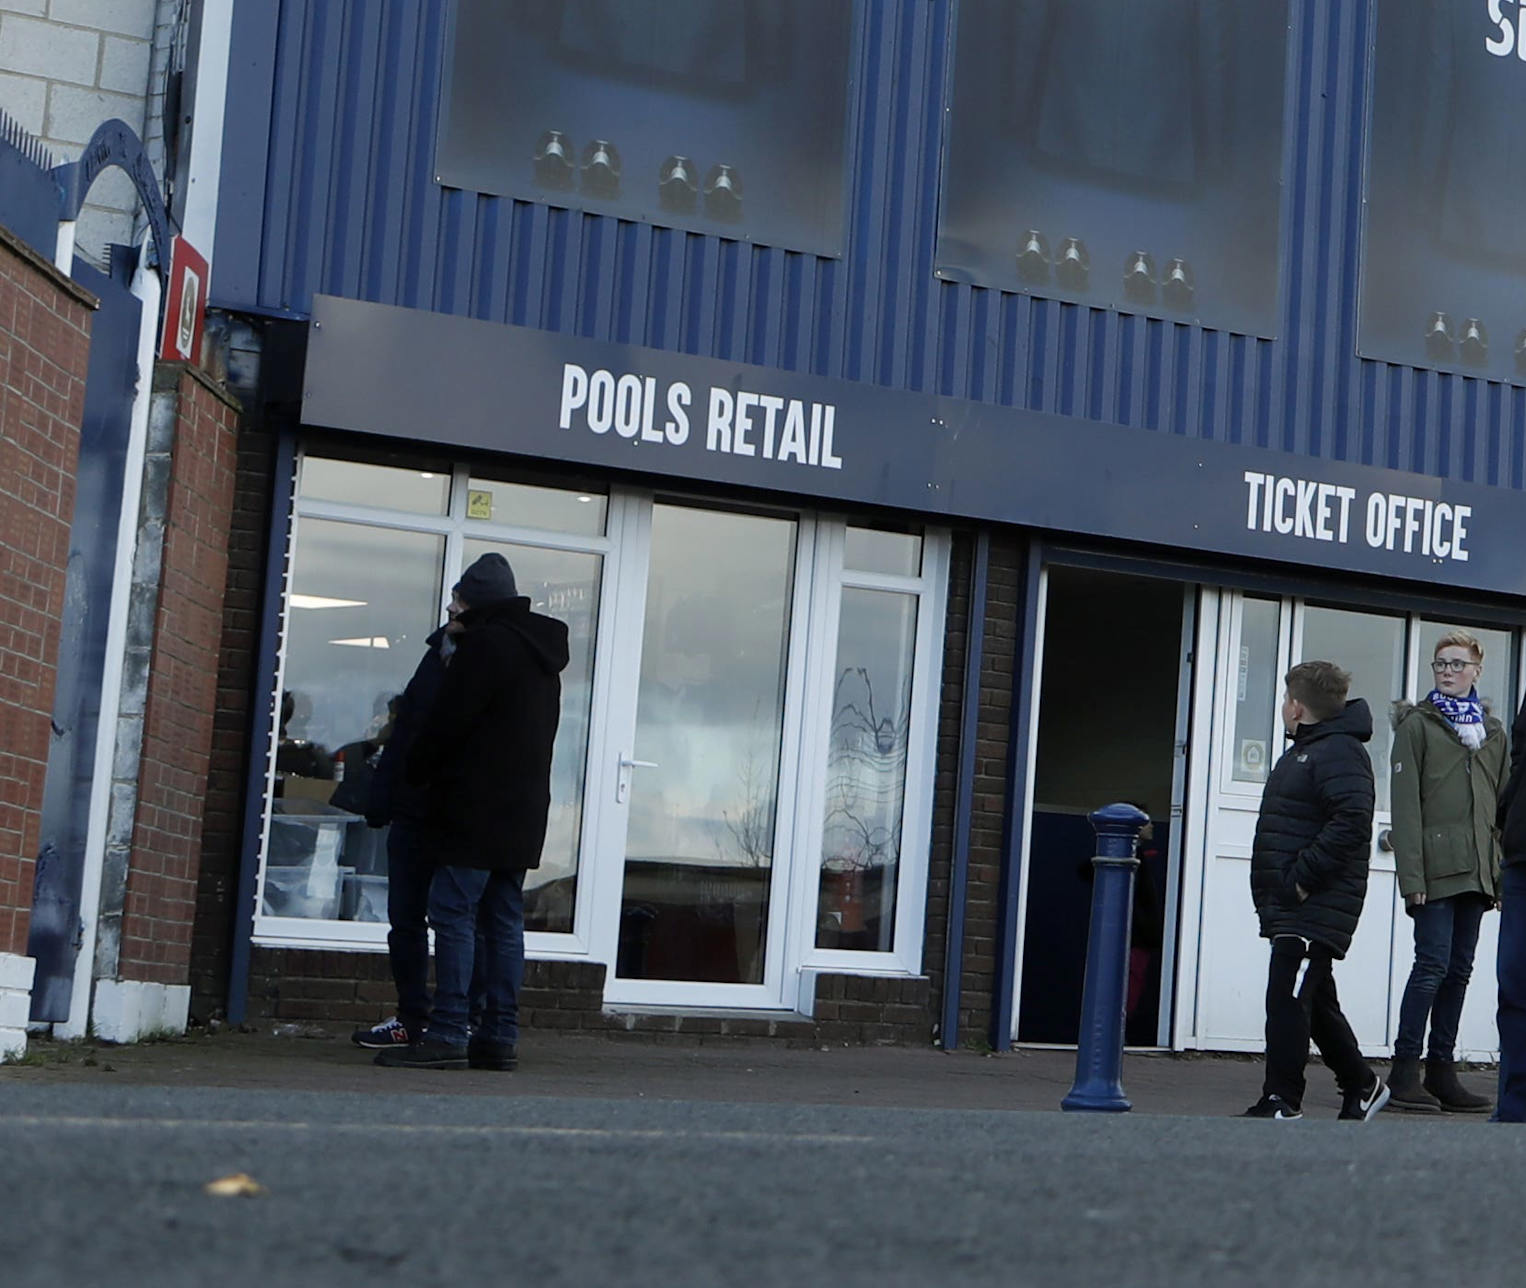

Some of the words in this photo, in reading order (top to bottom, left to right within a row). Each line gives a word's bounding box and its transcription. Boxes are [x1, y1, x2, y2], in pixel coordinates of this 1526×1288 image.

[559, 363, 692, 445] POOLS
[706, 387, 842, 469] RETAIL
[1244, 471, 1356, 544] TICKET
[1366, 492, 1472, 561] OFFICE
